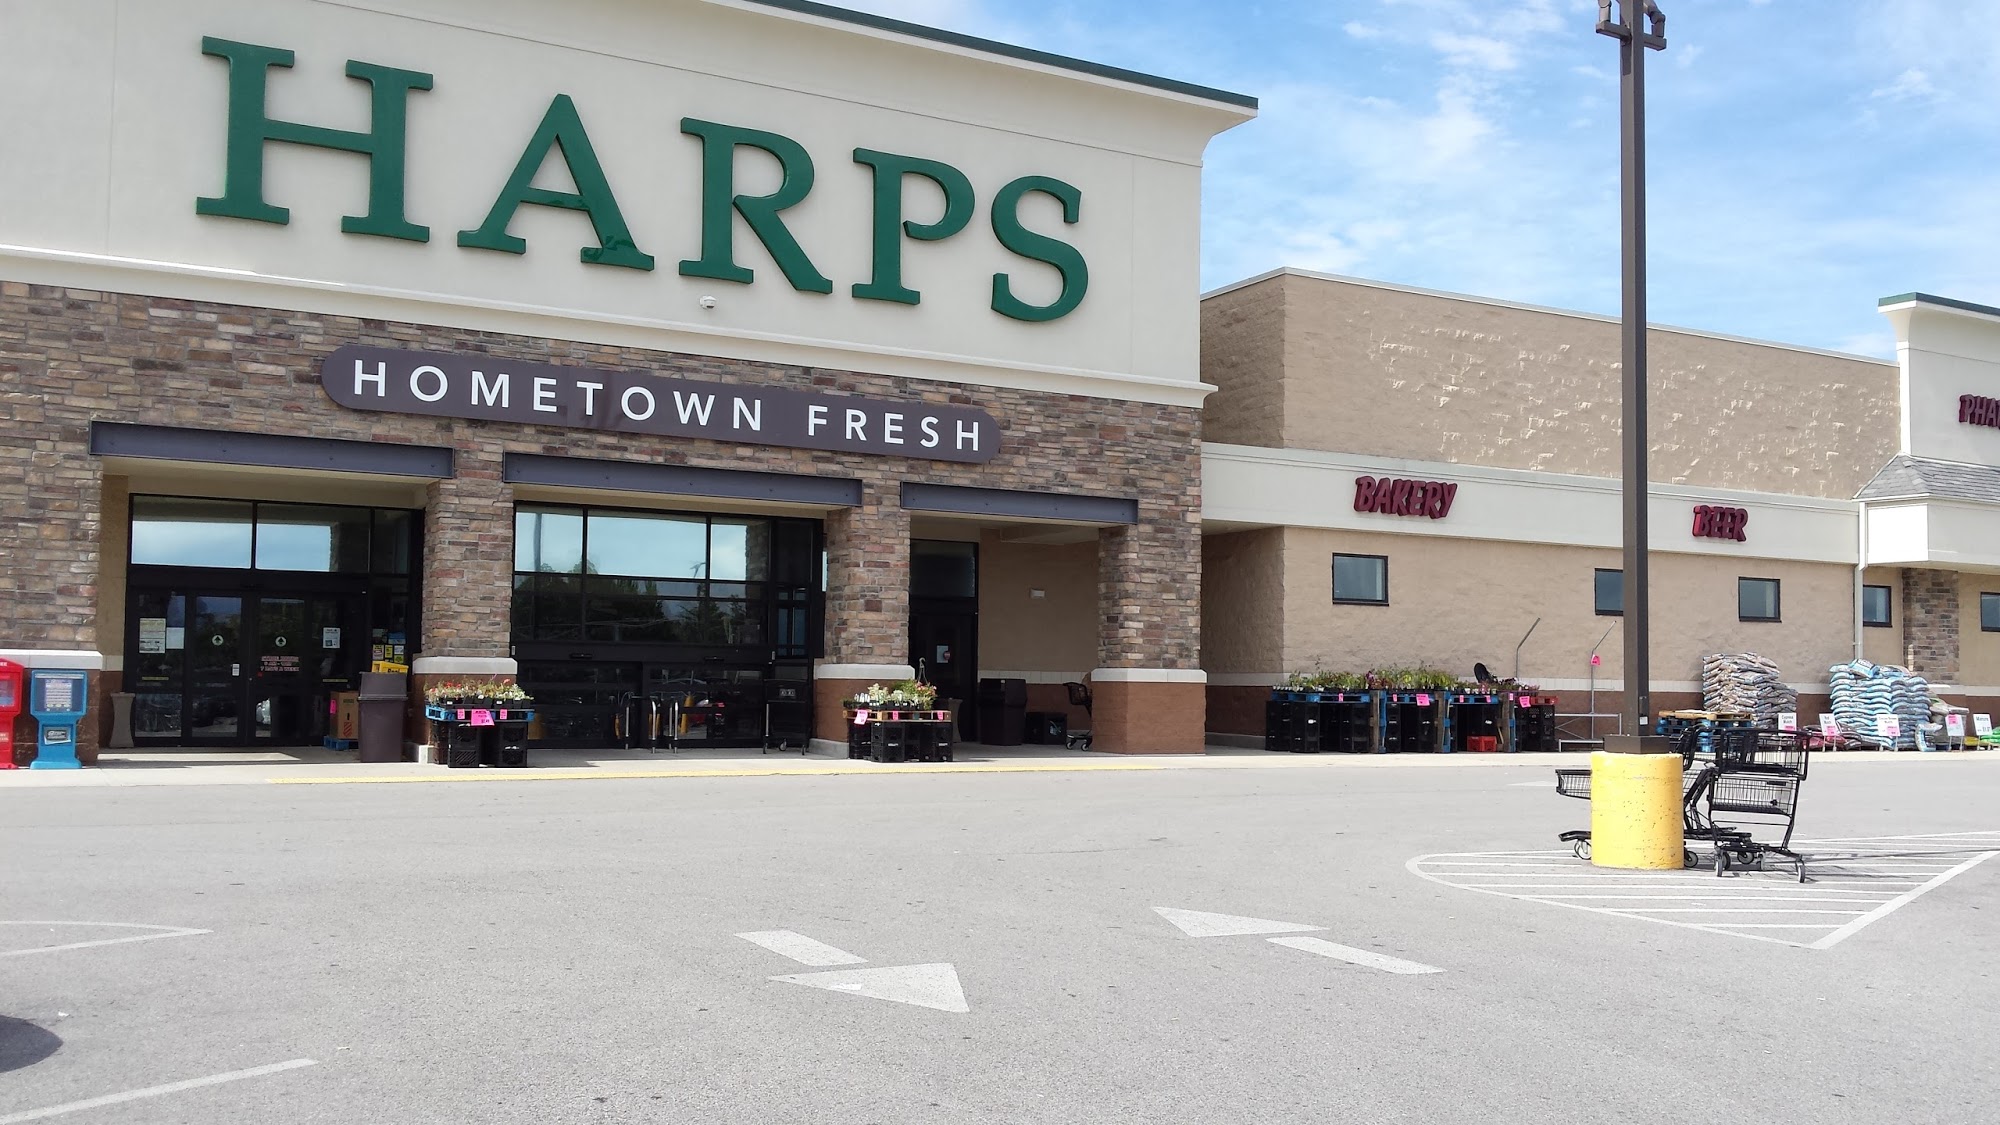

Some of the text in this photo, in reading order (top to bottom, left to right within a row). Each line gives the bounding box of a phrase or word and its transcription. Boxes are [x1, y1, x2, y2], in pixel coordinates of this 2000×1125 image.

[196, 36, 1089, 322] HARPS
[353, 359, 980, 452] HOMETOWN FRESH
[1959, 394, 2000, 430] PHA
[1354, 476, 1458, 519] BAKERY
[1692, 505, 1748, 542] BEER
